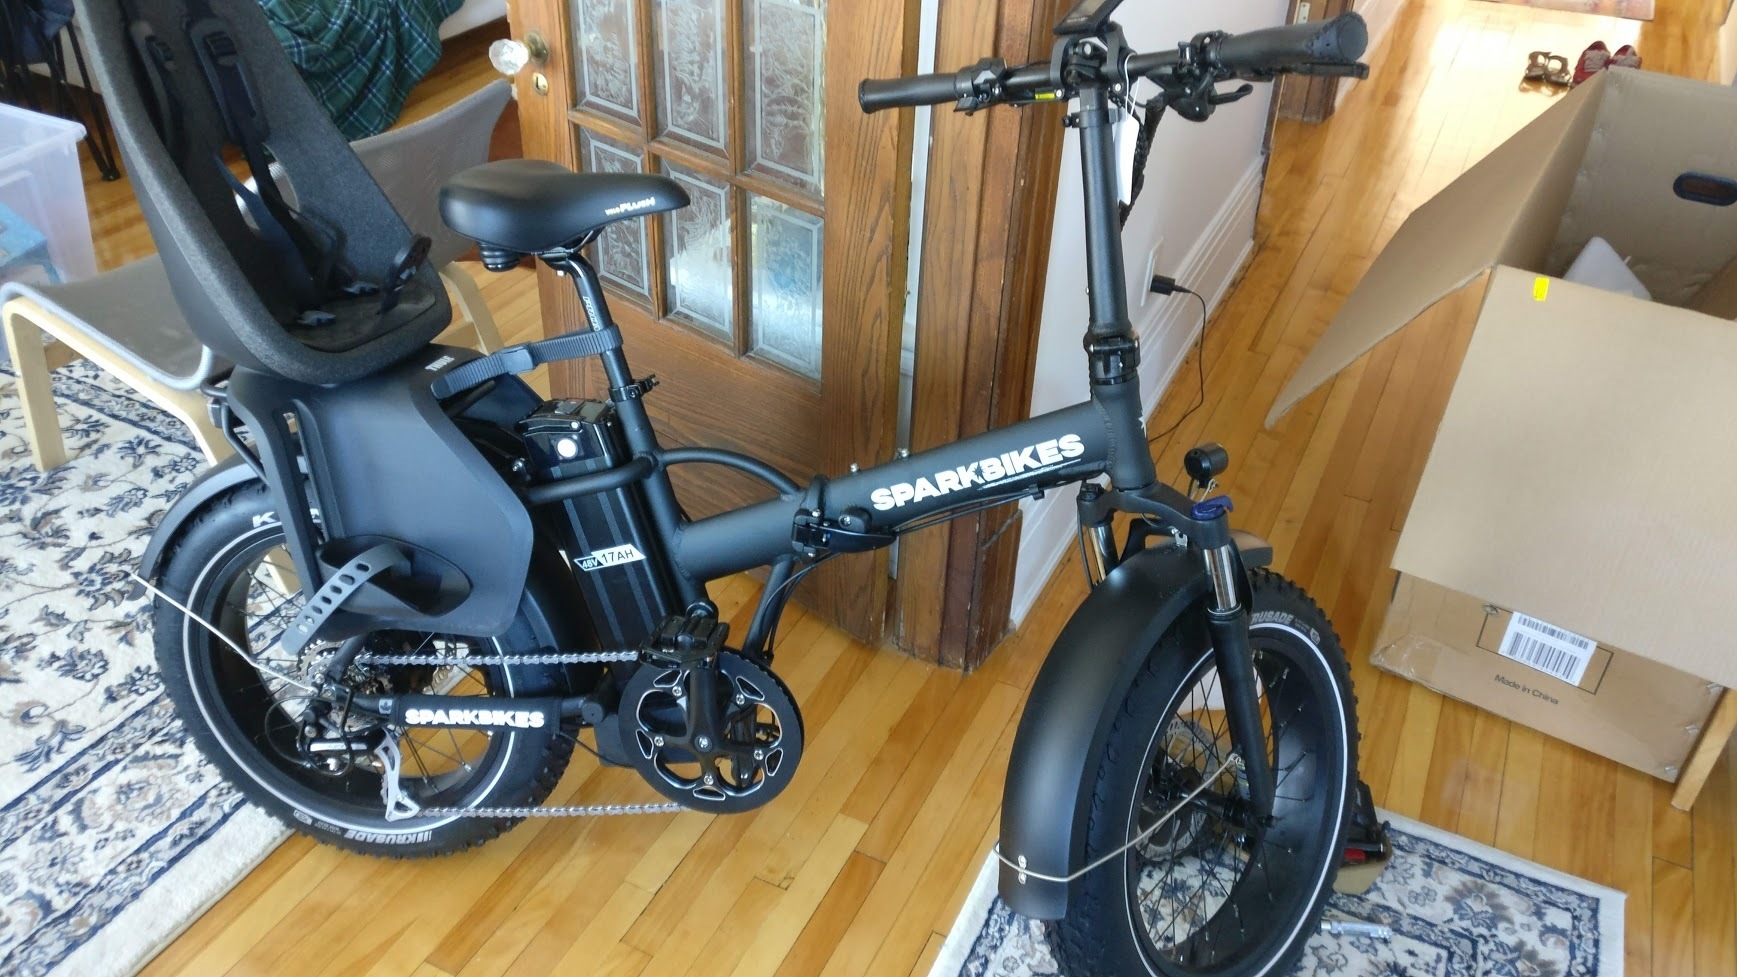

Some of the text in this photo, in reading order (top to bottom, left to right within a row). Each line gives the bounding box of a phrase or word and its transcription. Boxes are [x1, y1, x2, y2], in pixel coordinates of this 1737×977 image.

[870, 433, 1085, 511] SPARKBIKES
[582, 549, 634, 569] 48V 17AH
[1250, 610, 1295, 625] RUSADE
[1494, 674, 1559, 705] Made in China
[405, 708, 545, 728] SPARKBIKES
[343, 829, 417, 844] KRUSADE
